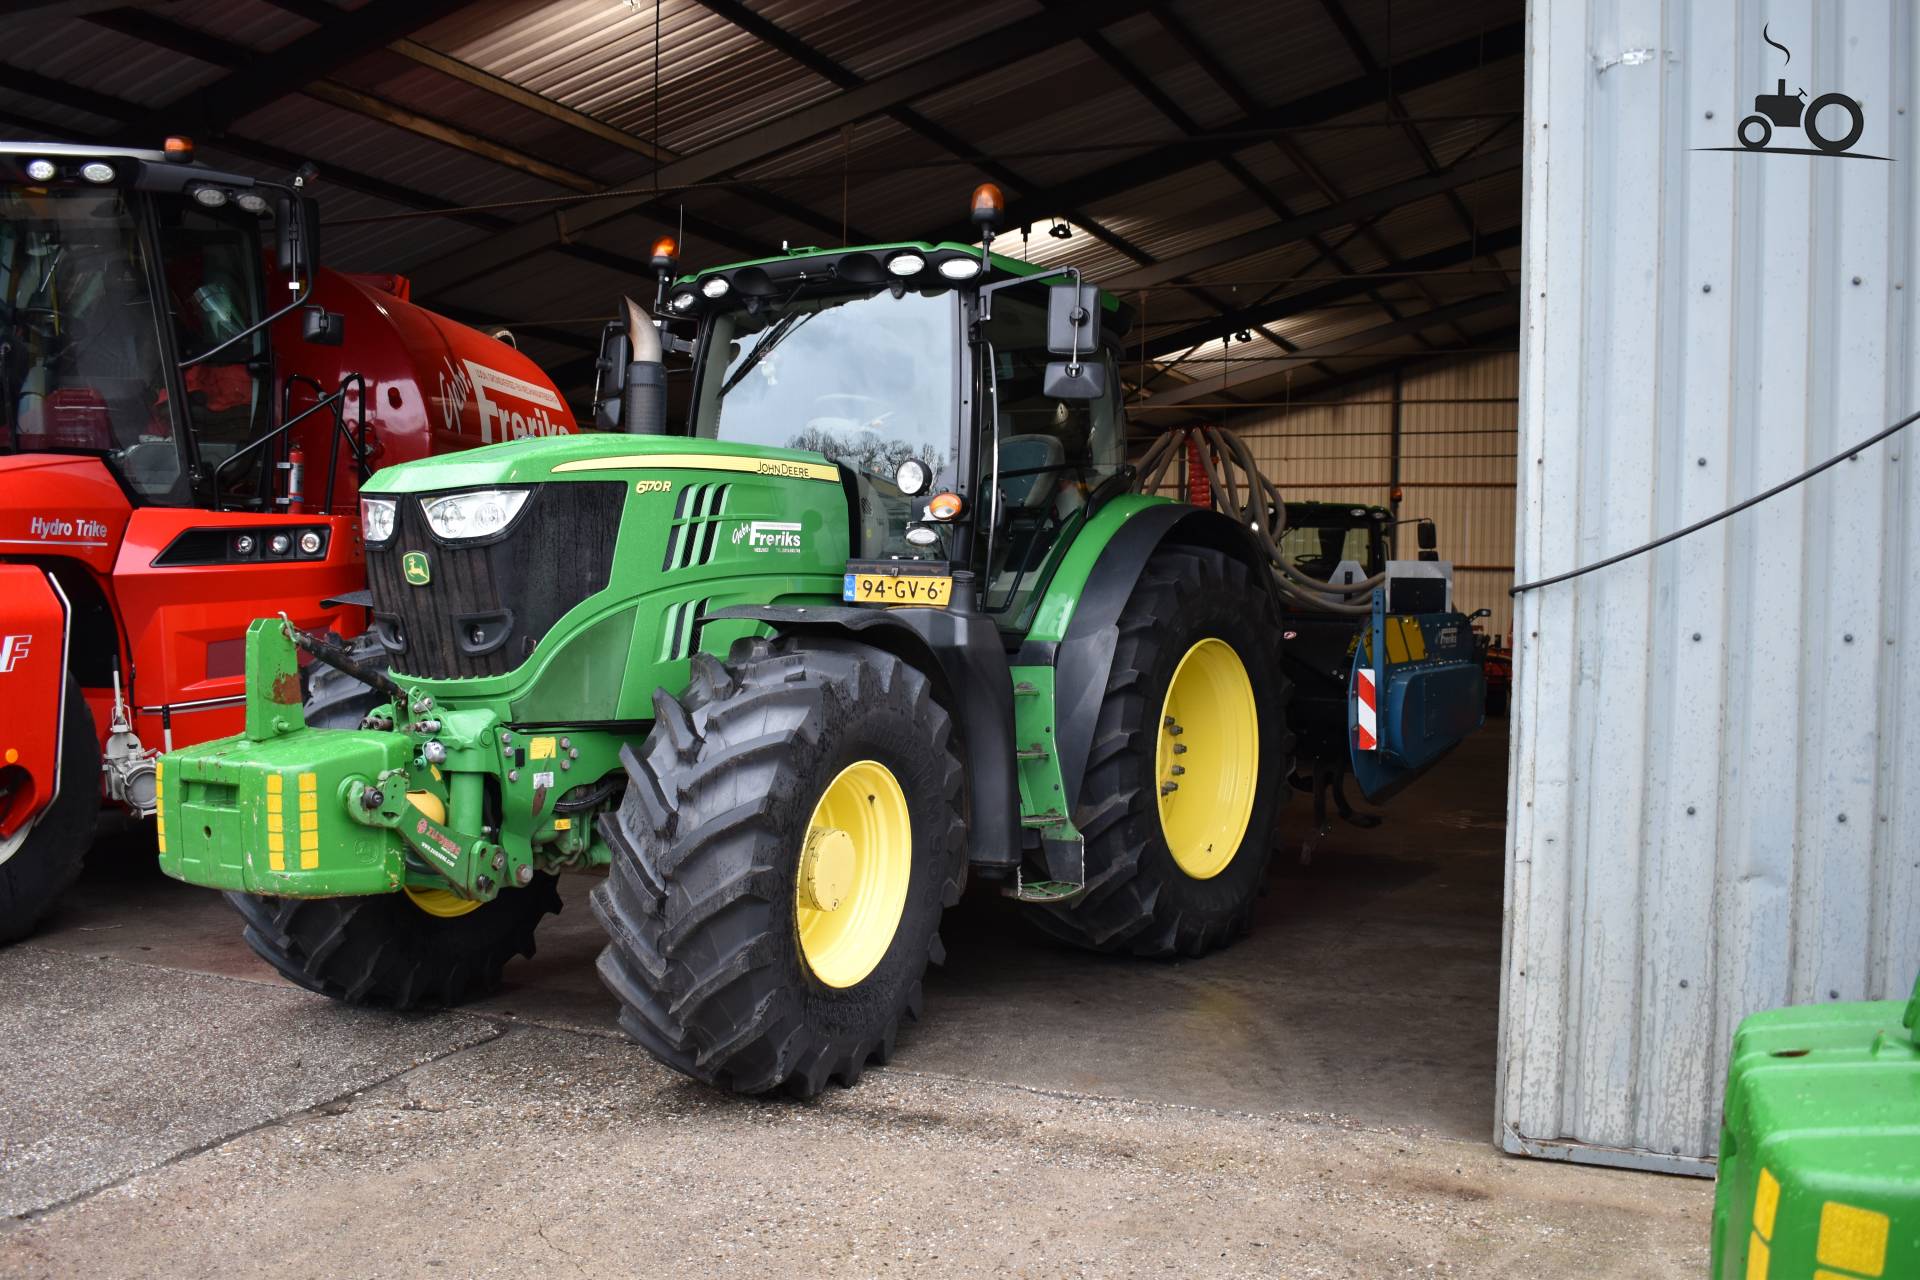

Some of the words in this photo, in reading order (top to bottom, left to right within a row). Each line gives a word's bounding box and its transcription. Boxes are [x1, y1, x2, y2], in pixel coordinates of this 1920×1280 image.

[462, 358, 570, 443] Frerik
[31, 516, 73, 539] Hydro
[76, 519, 108, 537] Trike
[748, 521, 801, 546] Freriks
